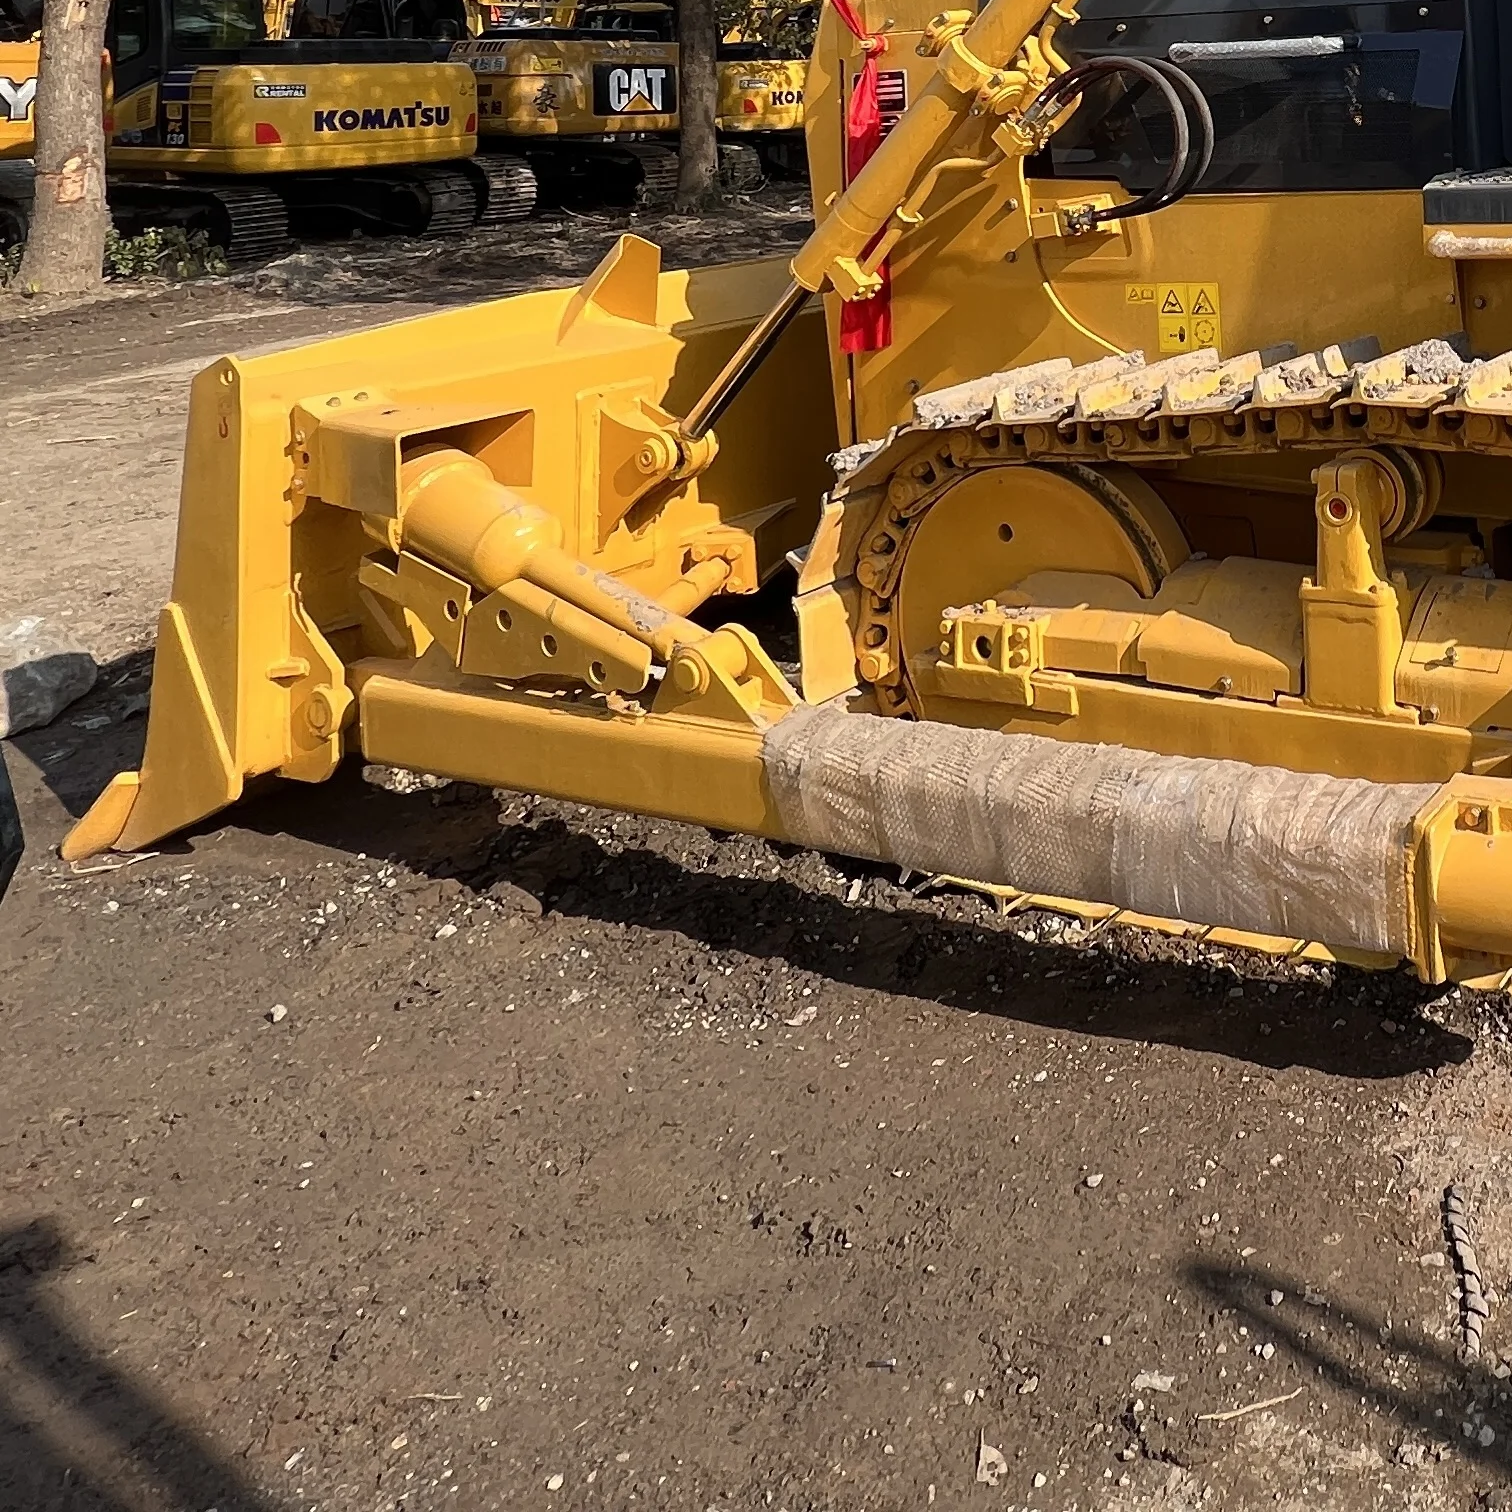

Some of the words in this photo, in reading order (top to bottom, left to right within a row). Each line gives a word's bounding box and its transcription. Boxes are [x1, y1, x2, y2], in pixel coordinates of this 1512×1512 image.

[609, 68, 666, 111] CAT
[314, 101, 450, 131] KOMATSU
[166, 134, 184, 144] 130
